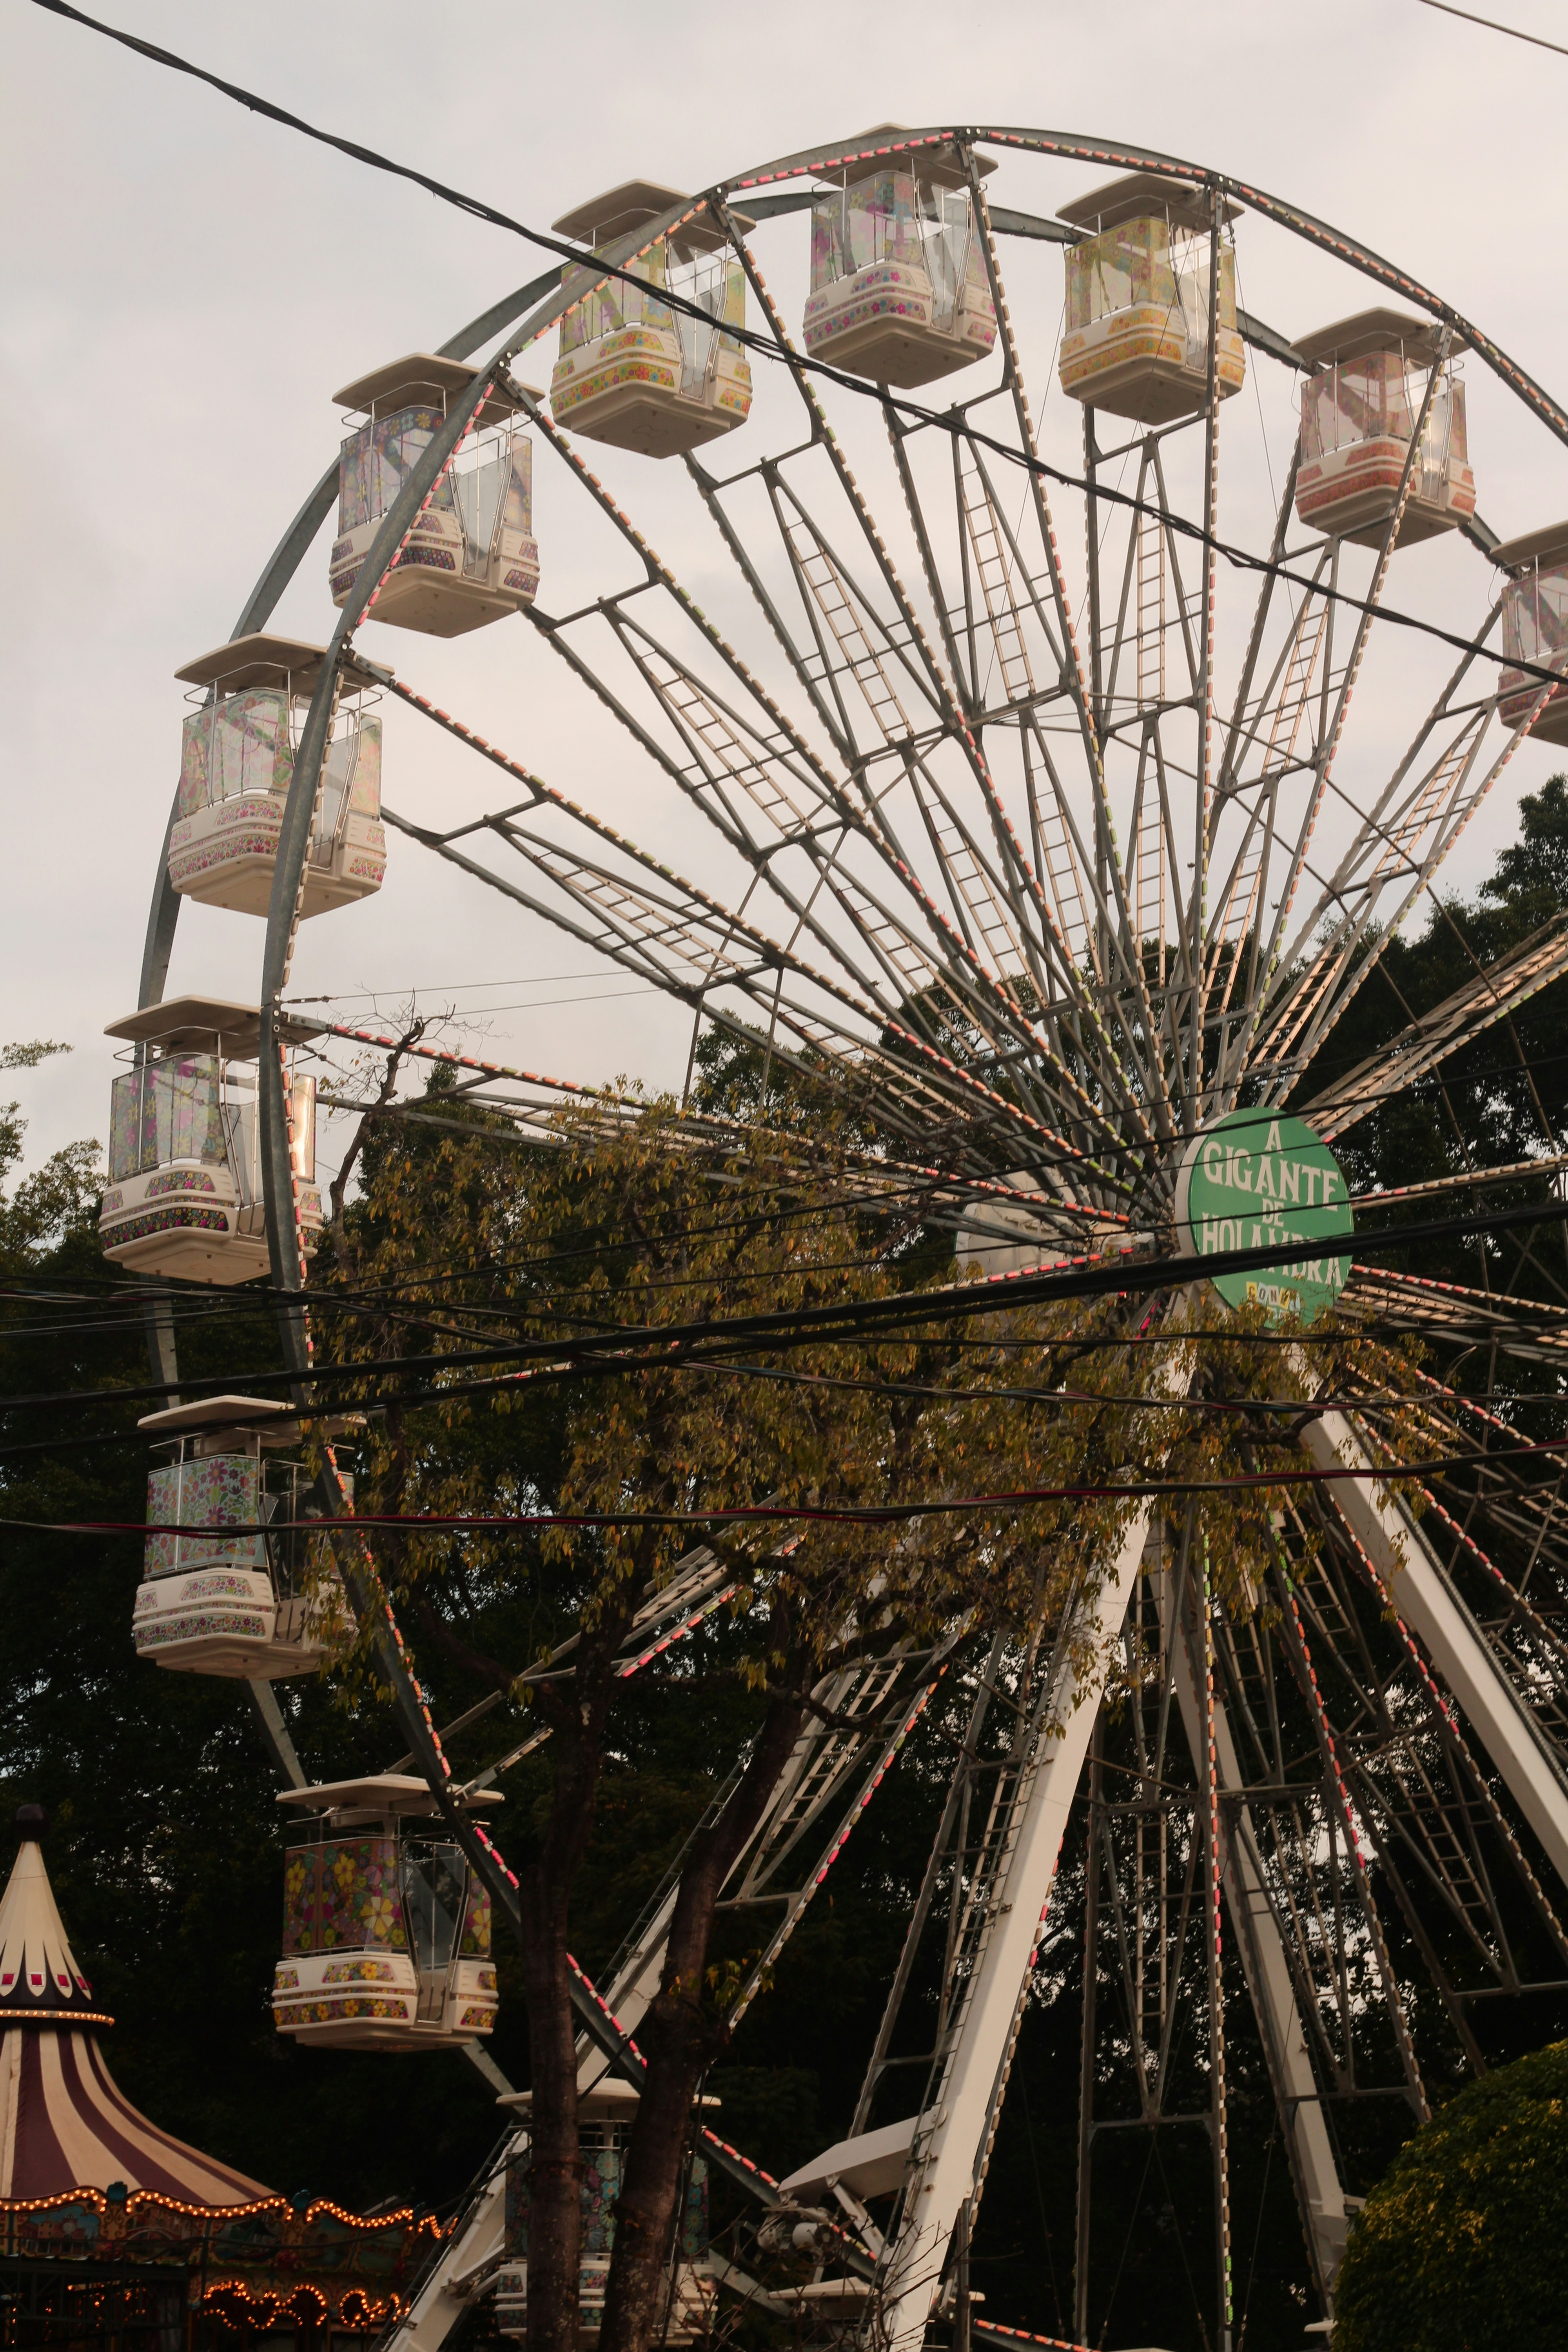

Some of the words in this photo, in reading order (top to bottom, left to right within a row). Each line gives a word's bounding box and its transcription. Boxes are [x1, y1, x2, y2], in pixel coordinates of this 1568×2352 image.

[1265, 1120, 1283, 1154] A
[1202, 1141, 1339, 1212] GIGANTE
[1262, 1198, 1285, 1228] DE
